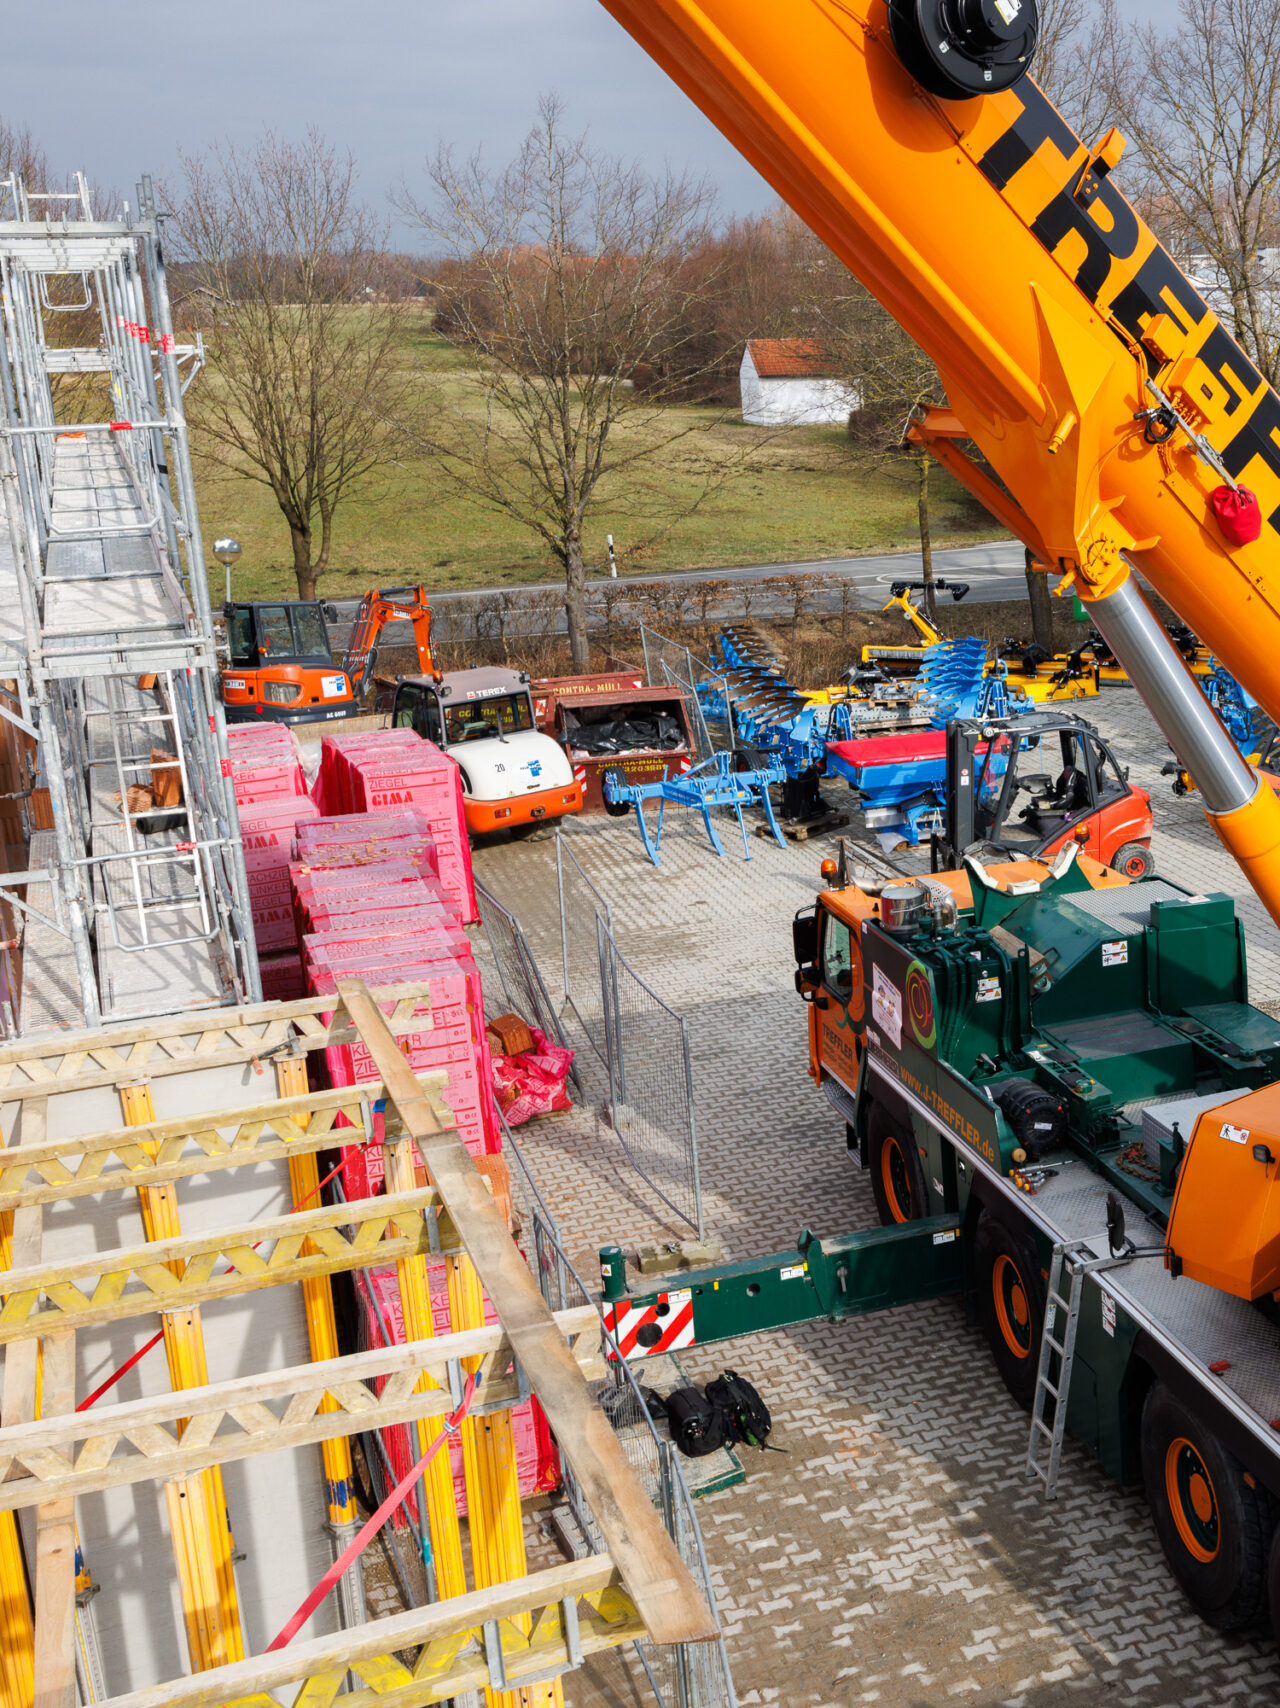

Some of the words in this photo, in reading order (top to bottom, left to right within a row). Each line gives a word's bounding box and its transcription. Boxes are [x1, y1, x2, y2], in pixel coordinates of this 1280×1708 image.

[476, 686, 507, 698] TEREX
[494, 763, 507, 774] 20
[368, 778, 407, 790] ZIEGEL
[240, 820, 269, 832] EGEL
[822, 1022, 854, 1062] TREFFLER
[901, 1065, 994, 1163] www.J-TREFFLER.de
